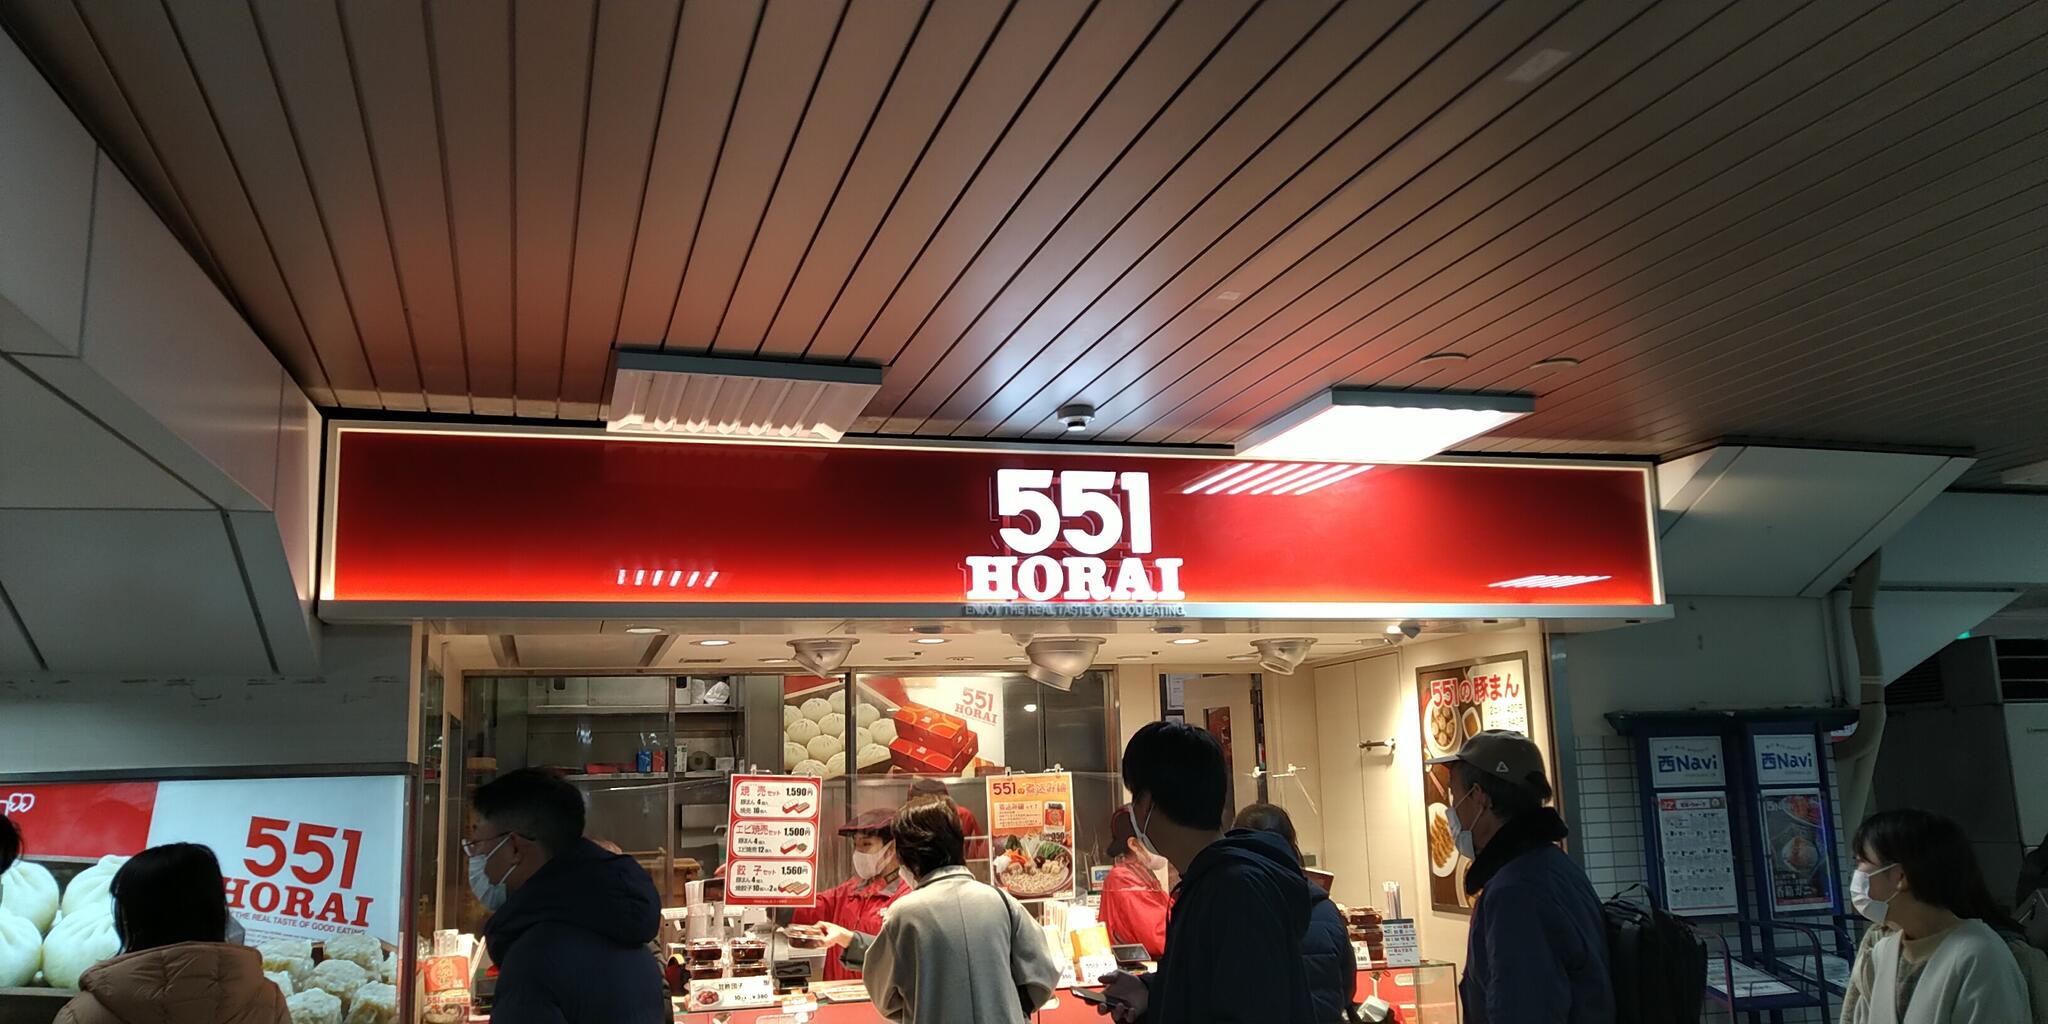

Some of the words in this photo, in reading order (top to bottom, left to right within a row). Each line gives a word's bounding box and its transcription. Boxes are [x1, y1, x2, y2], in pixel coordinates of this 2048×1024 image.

[997, 469, 1152, 554] 551
[966, 555, 1186, 601] HORAI
[967, 603, 1000, 617] ENJOY
[1003, 603, 1024, 617] THE
[1025, 603, 1055, 617] REAL
[1057, 603, 1091, 617] TASTE
[1094, 603, 1109, 617] OF
[1111, 603, 1144, 617] GOOD
[962, 686, 994, 711] 551
[1431, 674, 1519, 707] 551の豚まん
[954, 703, 998, 724] HORAI
[1658, 754, 1719, 772] 西Navi
[1761, 752, 1813, 770] 西Navi
[243, 816, 362, 890] 551
[223, 876, 374, 927] HORAI
[235, 911, 249, 921] THE
[251, 913, 271, 923] REAL
[274, 916, 297, 928] TASTE
[299, 920, 309, 929] OF
[311, 922, 335, 933] GOOD
